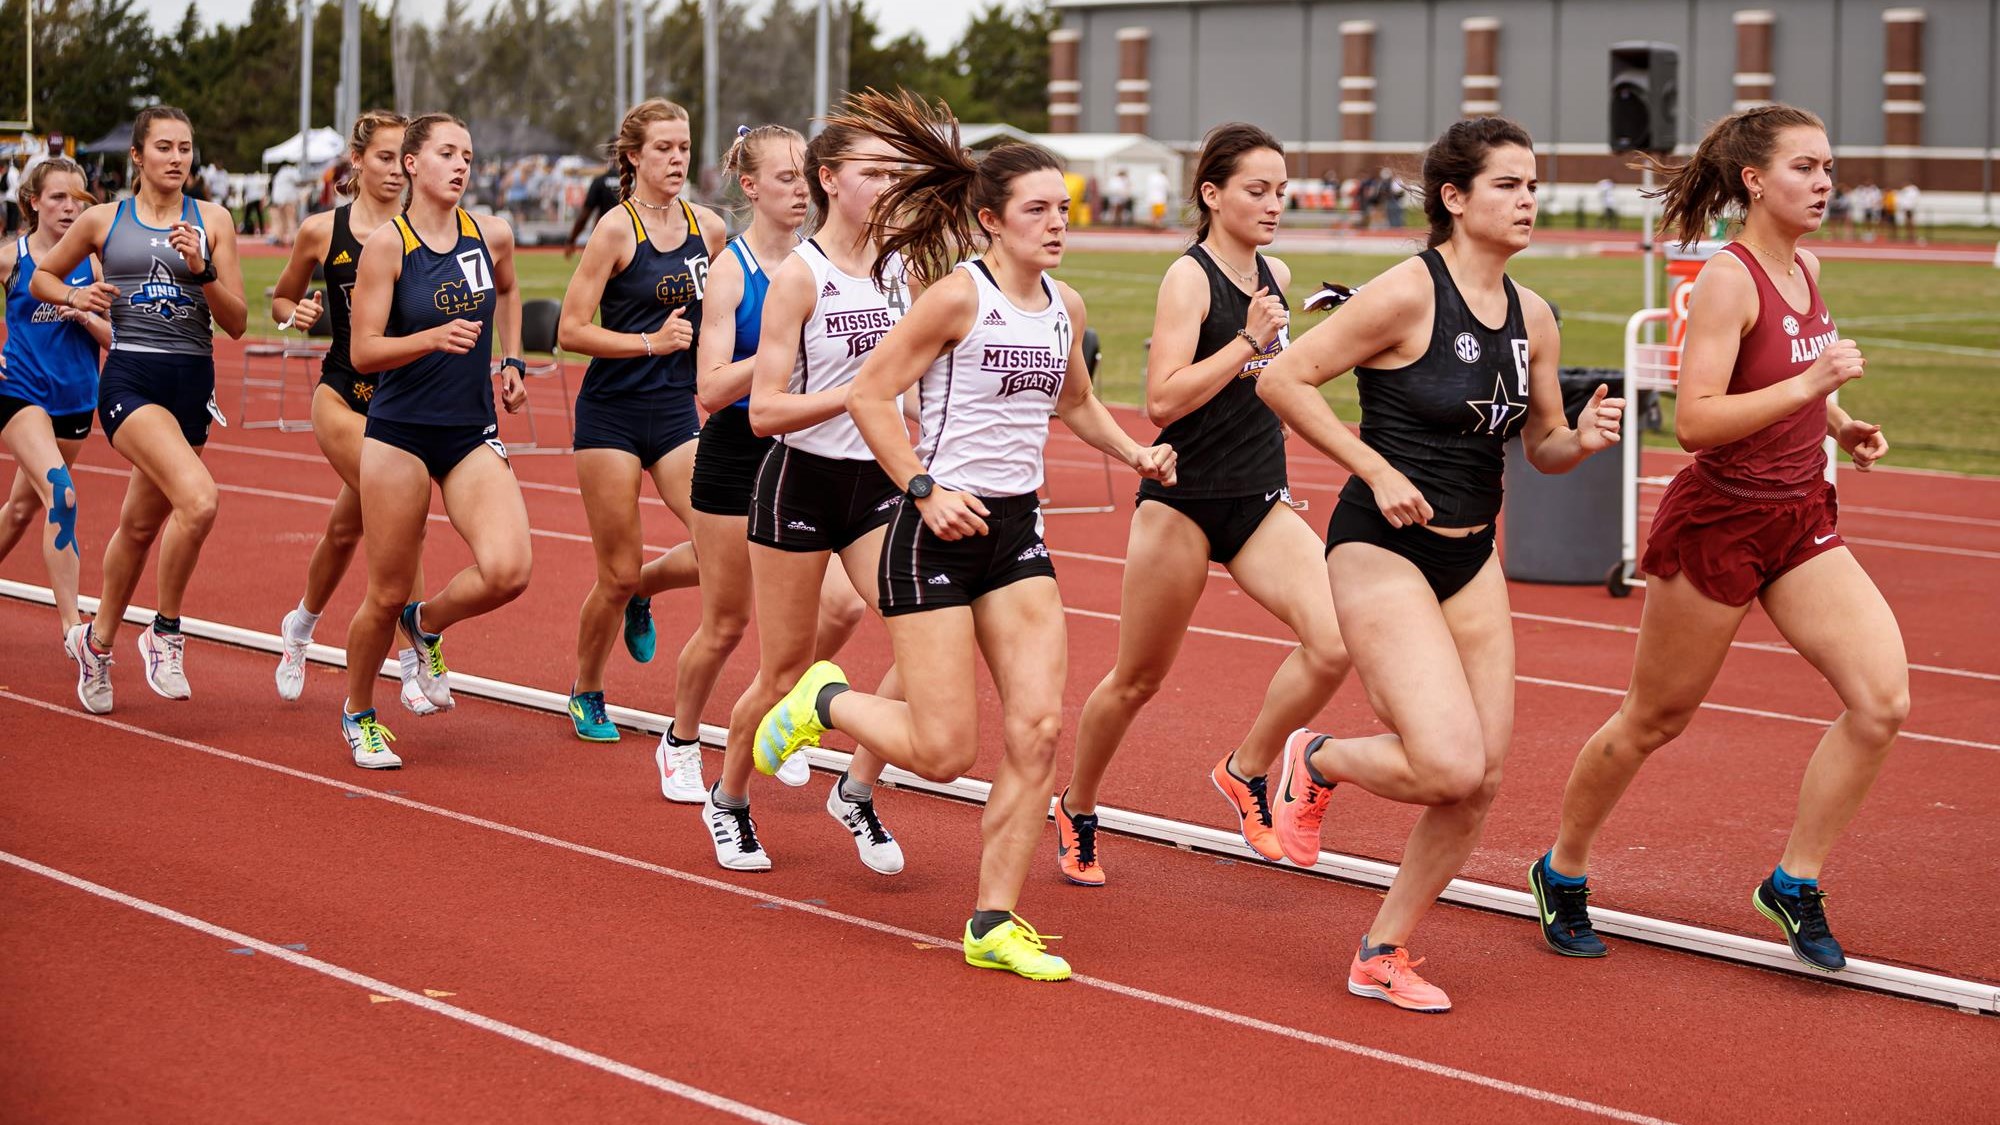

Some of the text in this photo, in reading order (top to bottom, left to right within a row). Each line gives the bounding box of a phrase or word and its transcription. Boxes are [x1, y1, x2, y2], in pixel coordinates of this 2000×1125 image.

[462, 253, 484, 288] 7
[695, 261, 707, 294] 6
[147, 284, 178, 298] UNO
[888, 276, 905, 316] 4
[825, 312, 884, 334] MISSISS
[1054, 321, 1069, 357] 11
[1456, 334, 1479, 361] SEC
[1244, 359, 1273, 372] TEC
[1518, 343, 1528, 394] 5
[1012, 373, 1054, 392] STATE
[1489, 404, 1509, 430] V
